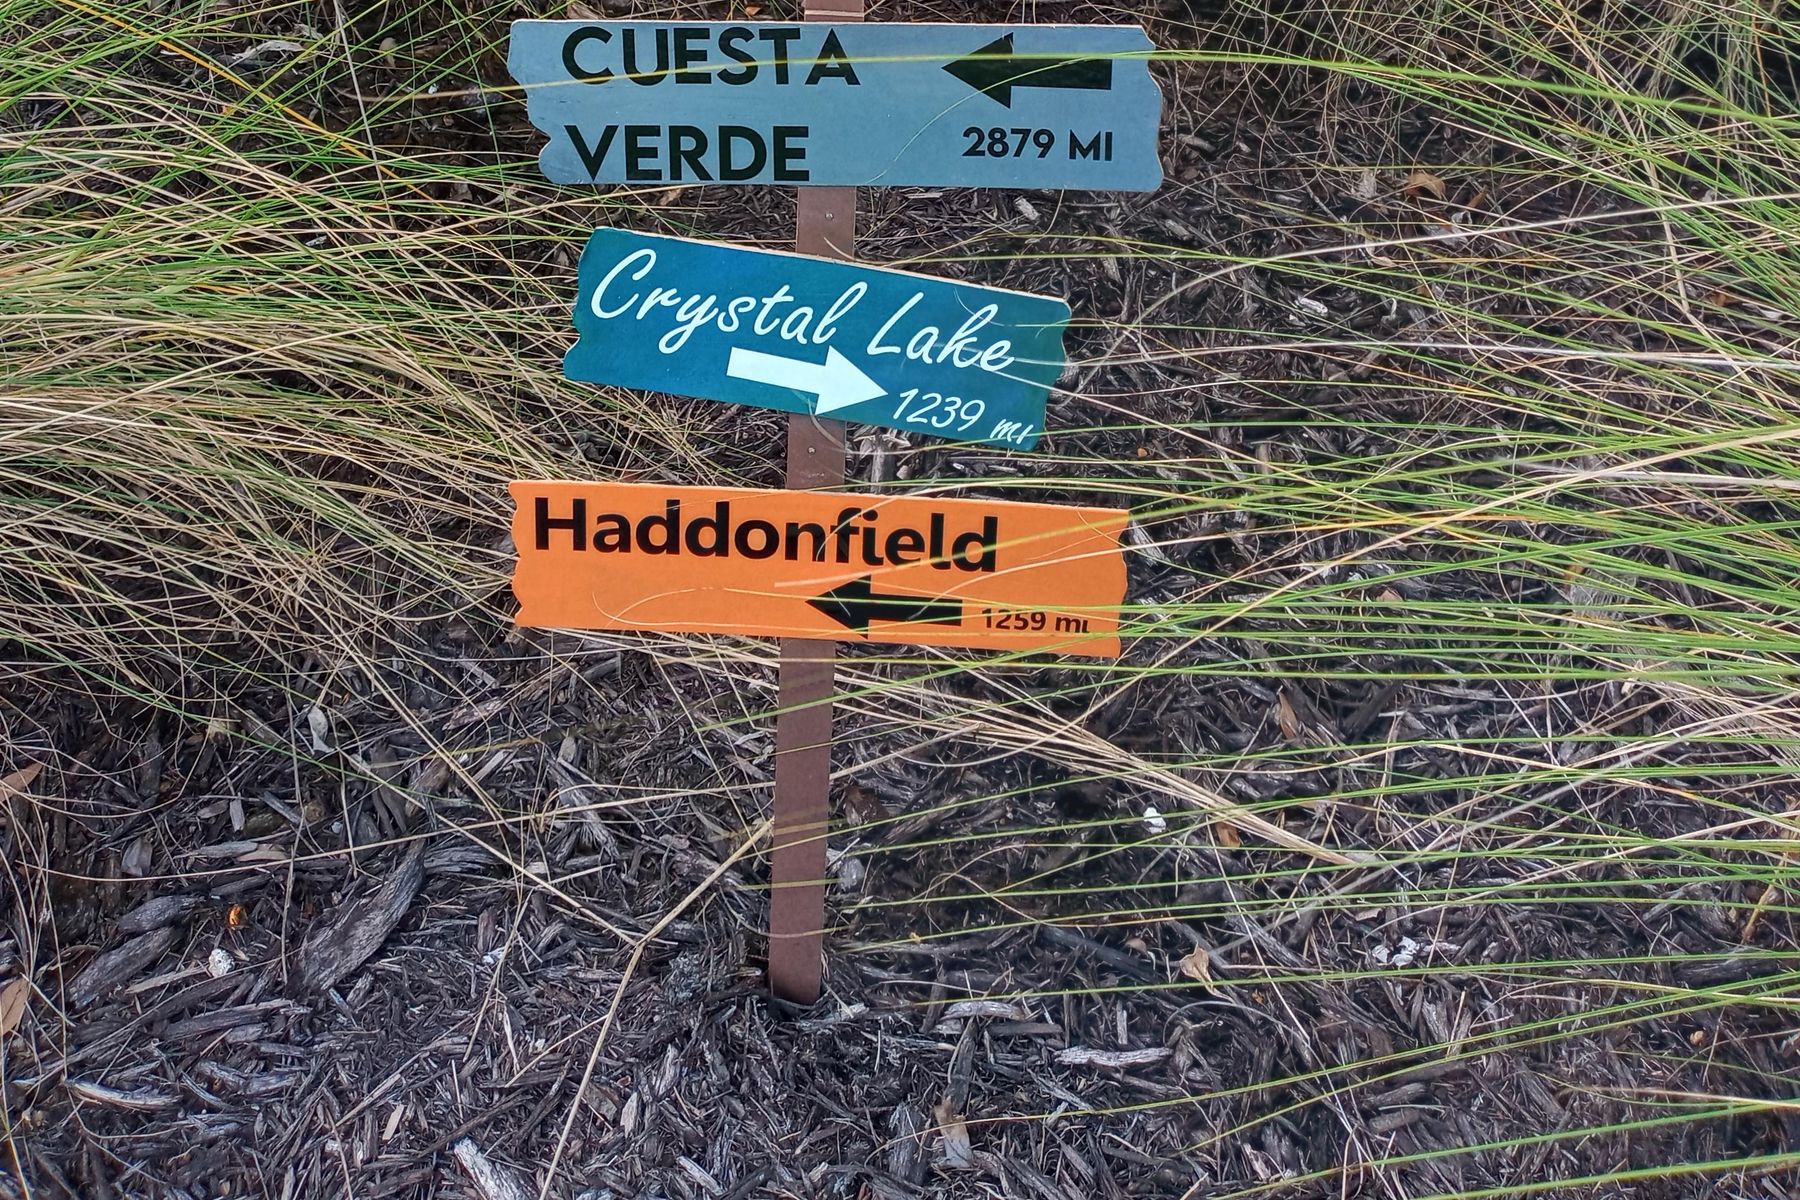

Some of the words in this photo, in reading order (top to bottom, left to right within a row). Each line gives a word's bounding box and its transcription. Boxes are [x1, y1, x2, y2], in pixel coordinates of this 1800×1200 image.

[561, 26, 861, 86] CUESTA
[563, 125, 810, 182] VERDE
[961, 126, 1055, 159] 2879
[1068, 131, 1114, 162] MI
[590, 248, 868, 355] Crystal
[866, 291, 1016, 373] Lake
[891, 387, 986, 432] 1239
[533, 497, 999, 573] Haddonfield
[981, 607, 1048, 633] 1259
